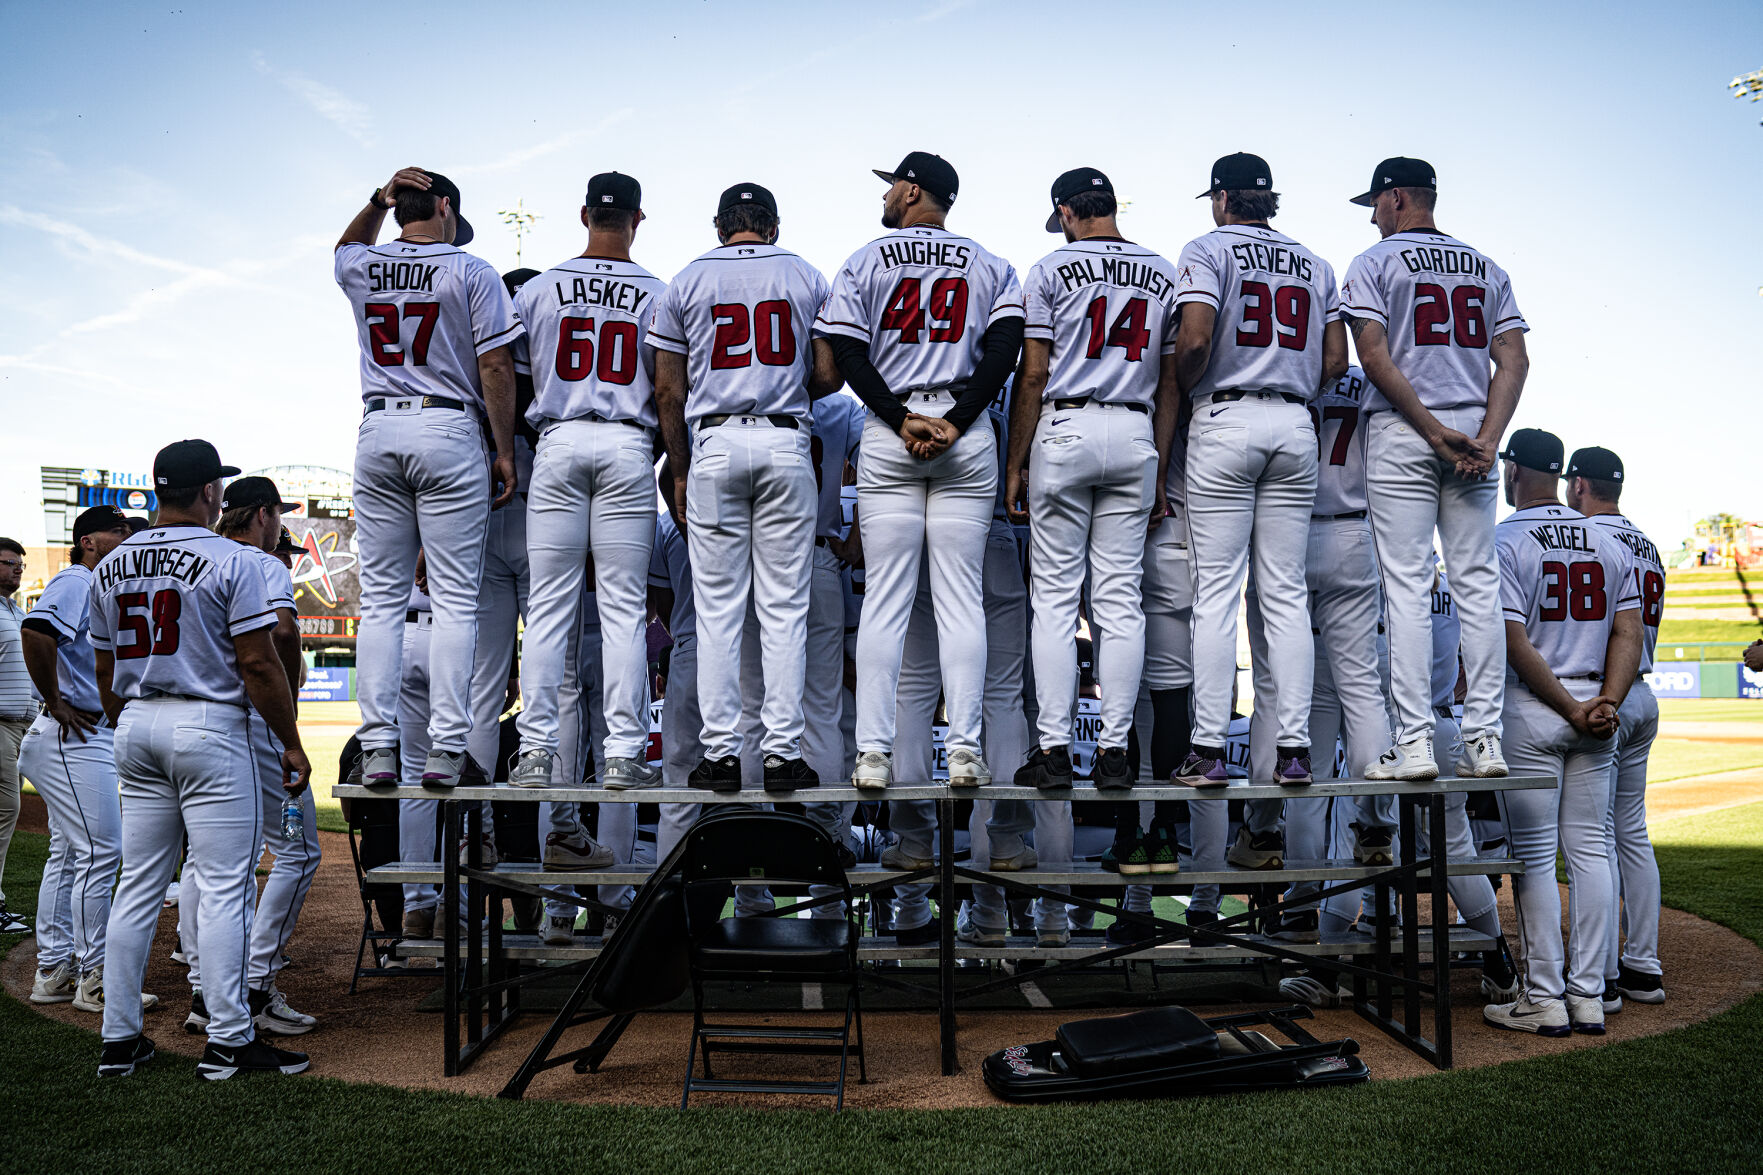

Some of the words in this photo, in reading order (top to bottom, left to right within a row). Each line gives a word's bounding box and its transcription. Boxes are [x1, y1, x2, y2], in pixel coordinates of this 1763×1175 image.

[368, 262, 439, 293] SHOOK
[880, 241, 970, 270] HUGHES
[1057, 257, 1174, 302] PALMQUIST
[1232, 243, 1313, 282] STEVENS
[1400, 247, 1487, 281] GORDON
[556, 277, 648, 314] LASKEY
[881, 276, 969, 344] 49
[1236, 280, 1311, 351] 39
[1414, 283, 1488, 349] 26
[365, 302, 440, 367] 27
[555, 316, 638, 385] 60
[711, 299, 796, 370] 20
[1086, 295, 1151, 362] 14
[1529, 524, 1596, 553] WEIGEL
[99, 547, 209, 593] HALVORSEN
[1539, 560, 1607, 622] 38
[116, 589, 182, 661] 58
